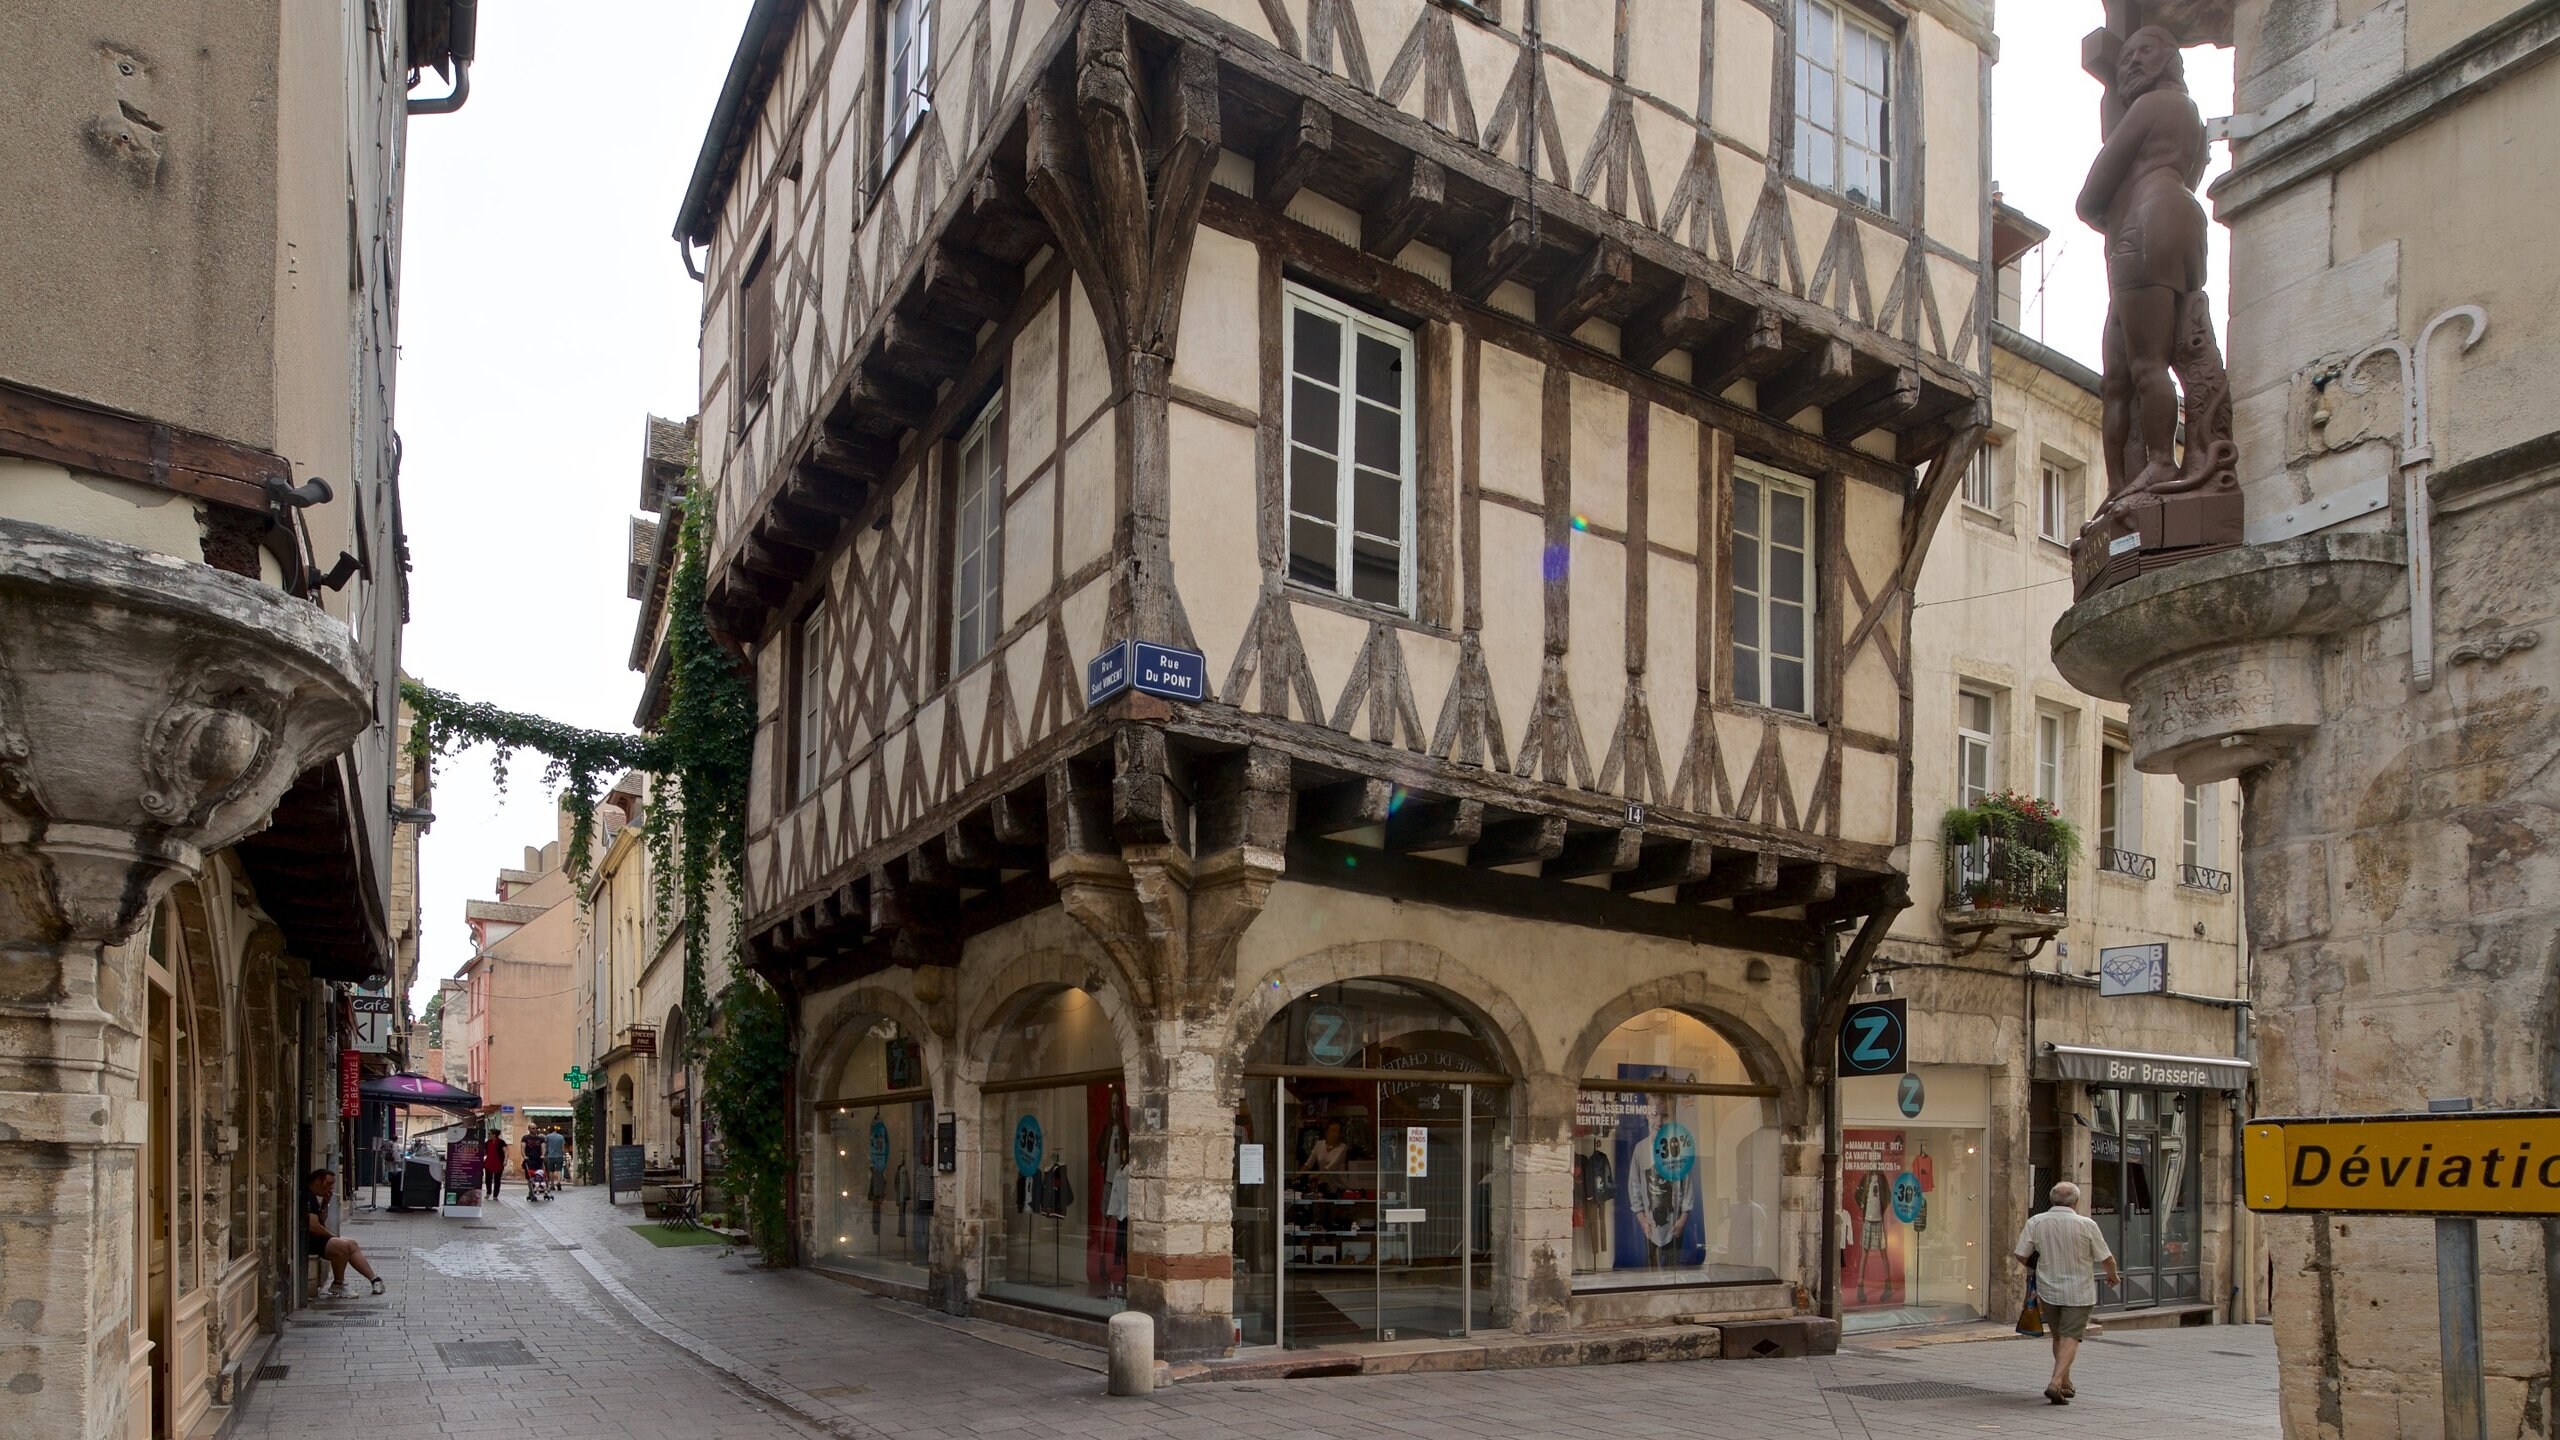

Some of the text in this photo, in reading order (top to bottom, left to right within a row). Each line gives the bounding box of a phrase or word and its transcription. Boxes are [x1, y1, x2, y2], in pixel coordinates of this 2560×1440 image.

[1101, 660, 1112, 673] Rue
[1160, 655, 1179, 669] Rue
[1102, 668, 1123, 688] VINCENT
[1145, 669, 1192, 688] Du PONT
[1628, 807, 1641, 823] 14
[2150, 944, 2163, 991] BAR
[352, 999, 389, 1011] Café
[1852, 1015, 1891, 1061] Z
[2110, 1061, 2206, 1084] Bar Brasserie
[1900, 1079, 1920, 1112] Z
[1576, 1103, 1595, 1113] FAUT
[1625, 1105, 1635, 1114] EN
[1635, 1105, 1657, 1115] MODE
[1576, 1114, 1609, 1126] RENTRÉE
[1853, 1152, 1868, 1161] VAUT
[1853, 1162, 1877, 1170] FASHION
